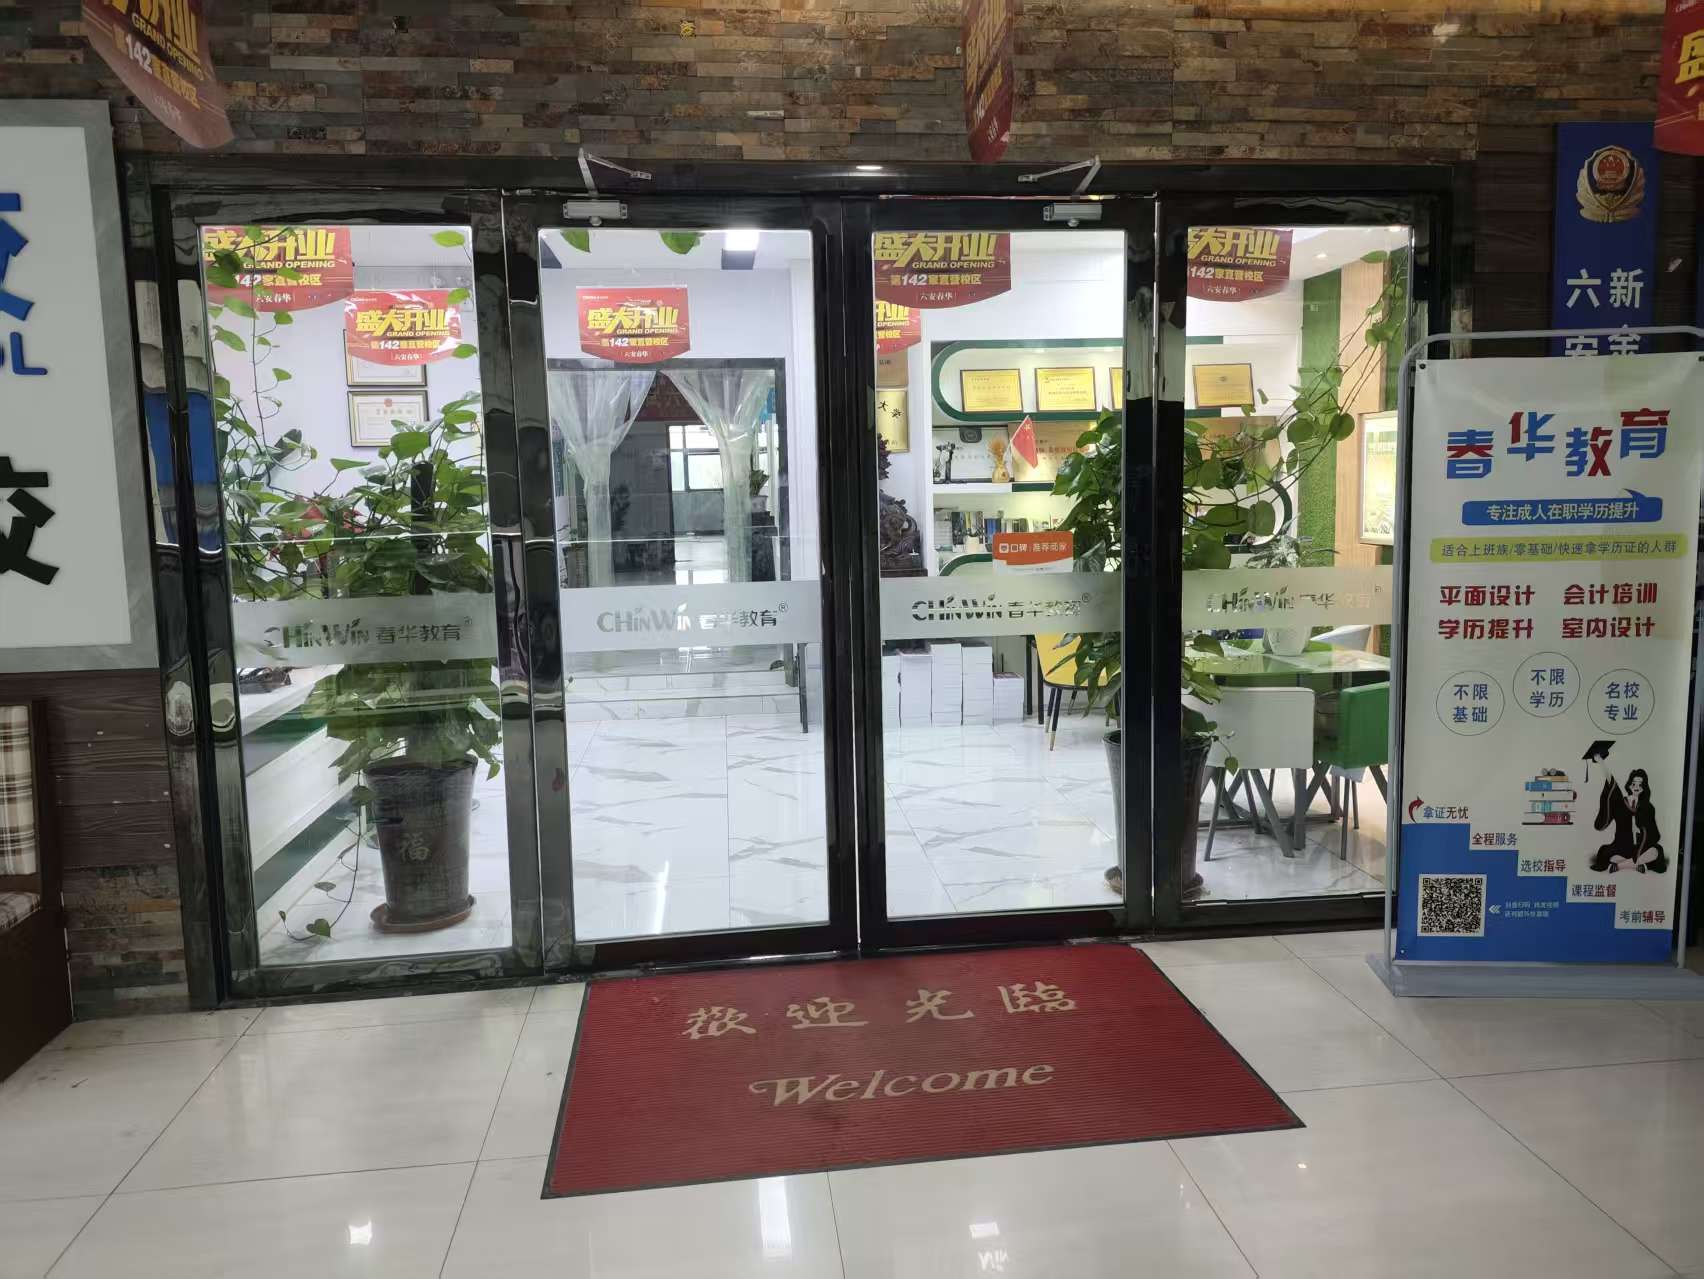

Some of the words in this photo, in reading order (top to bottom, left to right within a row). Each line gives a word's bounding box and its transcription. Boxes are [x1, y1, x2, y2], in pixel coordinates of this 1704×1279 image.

[875, 232, 997, 267] 盛大开业
[285, 260, 336, 268] OPENING
[912, 261, 947, 269] GRAND
[949, 261, 995, 269] OPENING
[1201, 255, 1234, 263] GRAND
[1236, 258, 1276, 267] OPENING
[355, 309, 450, 337] 盛大开业
[587, 307, 679, 334] 盛大开业
[1446, 408, 1671, 479] 春华教育
[1486, 502, 1639, 520] 专注成人在职学历提升
[1440, 584, 1536, 606] 平面设计
[1563, 582, 1658, 605] 会计培训
[1438, 618, 1534, 640] 学历提升
[1562, 616, 1656, 638] 室内设计
[1531, 668, 1565, 686] 不限
[1454, 684, 1488, 700] 不限
[1530, 691, 1564, 708] 学历
[1605, 682, 1640, 700] 名校
[1453, 706, 1488, 723] 基础
[1604, 704, 1638, 721] 专业
[1422, 806, 1469, 819] 拿证无忧
[1471, 832, 1518, 846] 全程服务
[1520, 859, 1567, 873] 选校指导
[1571, 884, 1616, 898] 课程监督
[1619, 910, 1665, 924] 考前辅导
[747, 1062, 1054, 1106] Welcome
